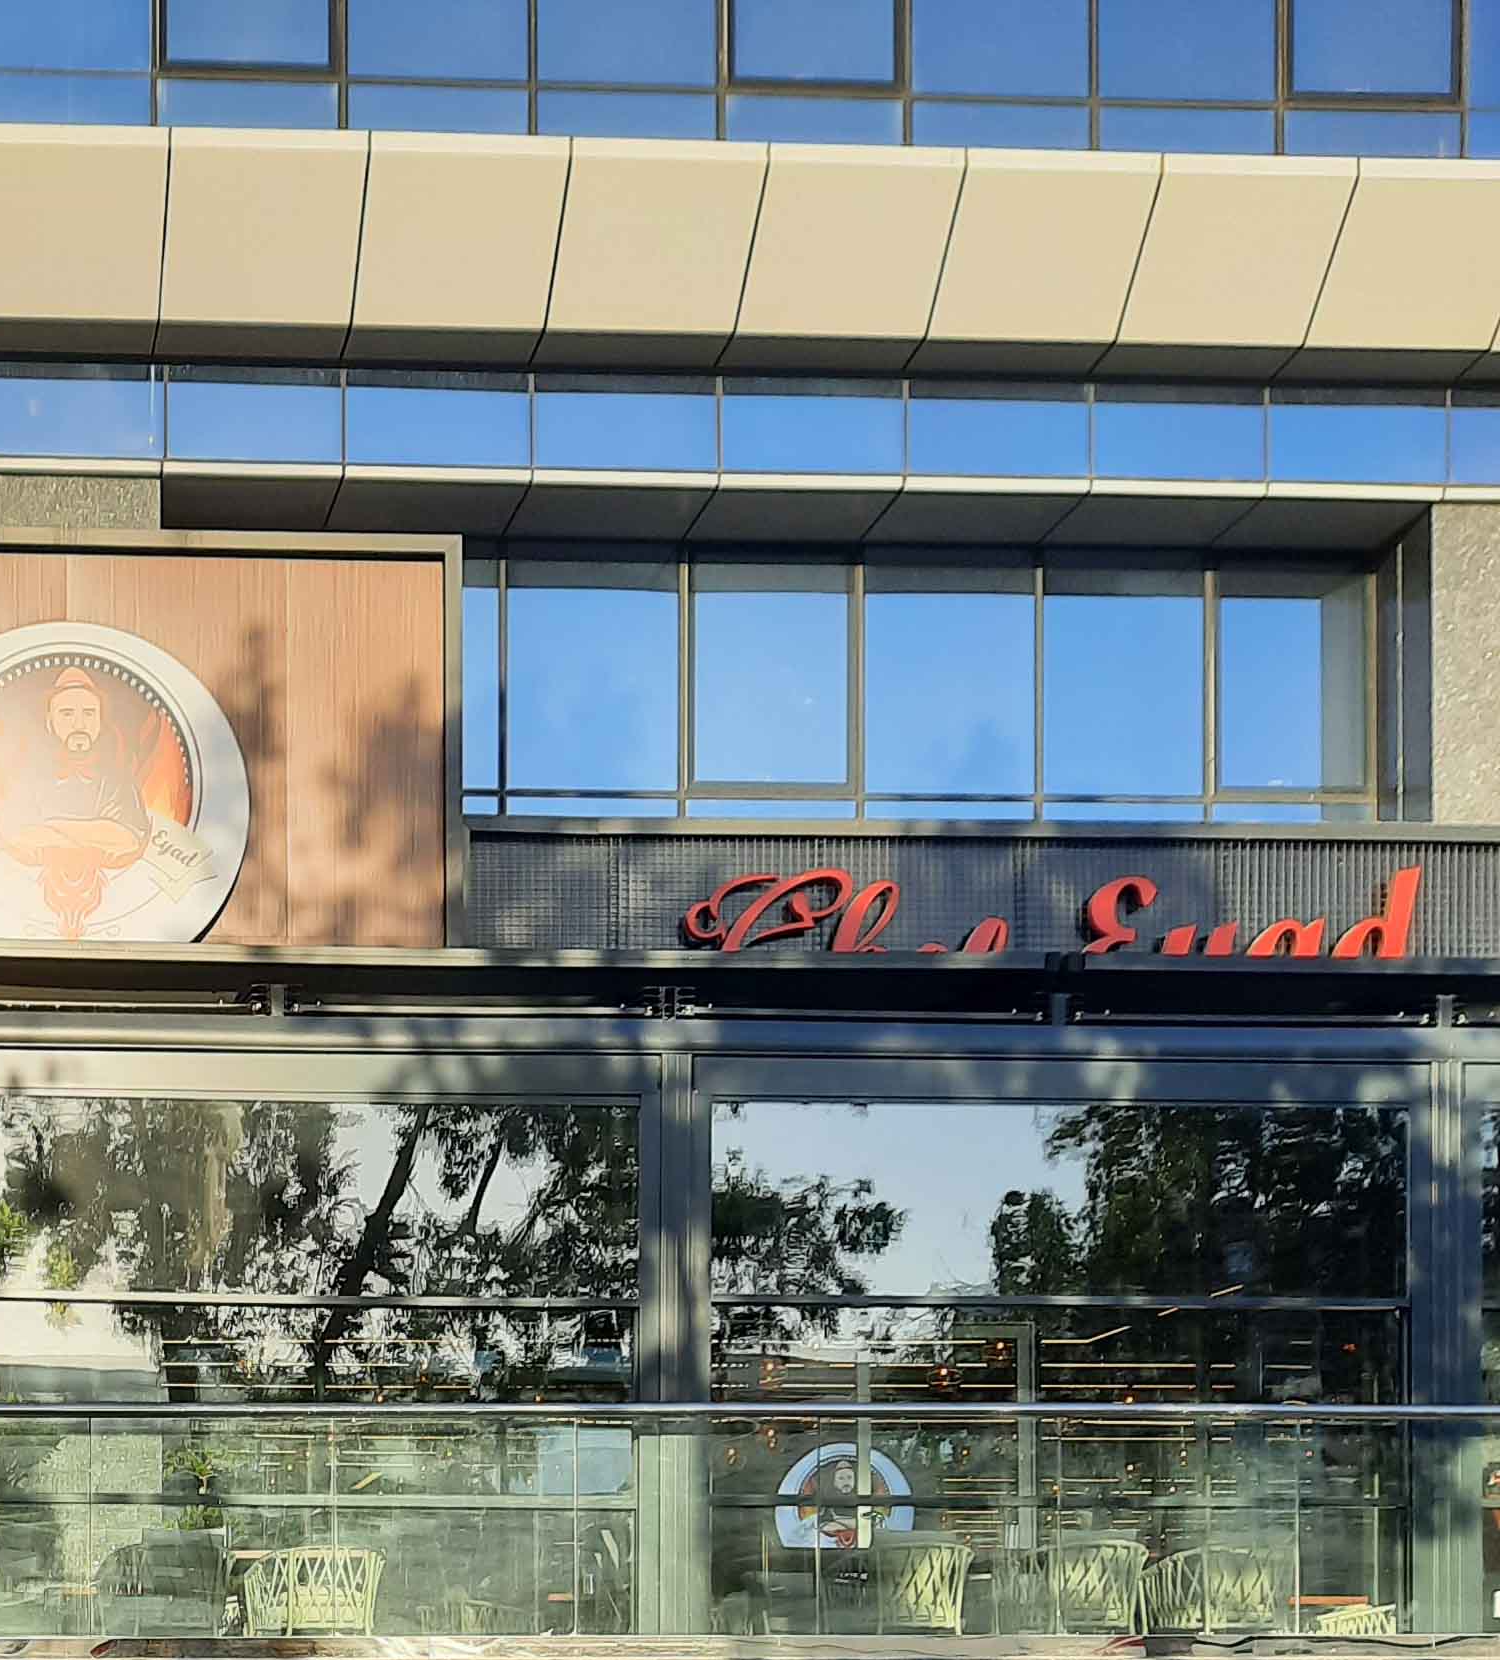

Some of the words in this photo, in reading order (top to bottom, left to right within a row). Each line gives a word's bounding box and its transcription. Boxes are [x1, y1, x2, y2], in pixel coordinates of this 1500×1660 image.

[150, 829, 198, 867] Eyad
[684, 868, 1009, 954] Ch
[1081, 864, 1421, 959] Ead
